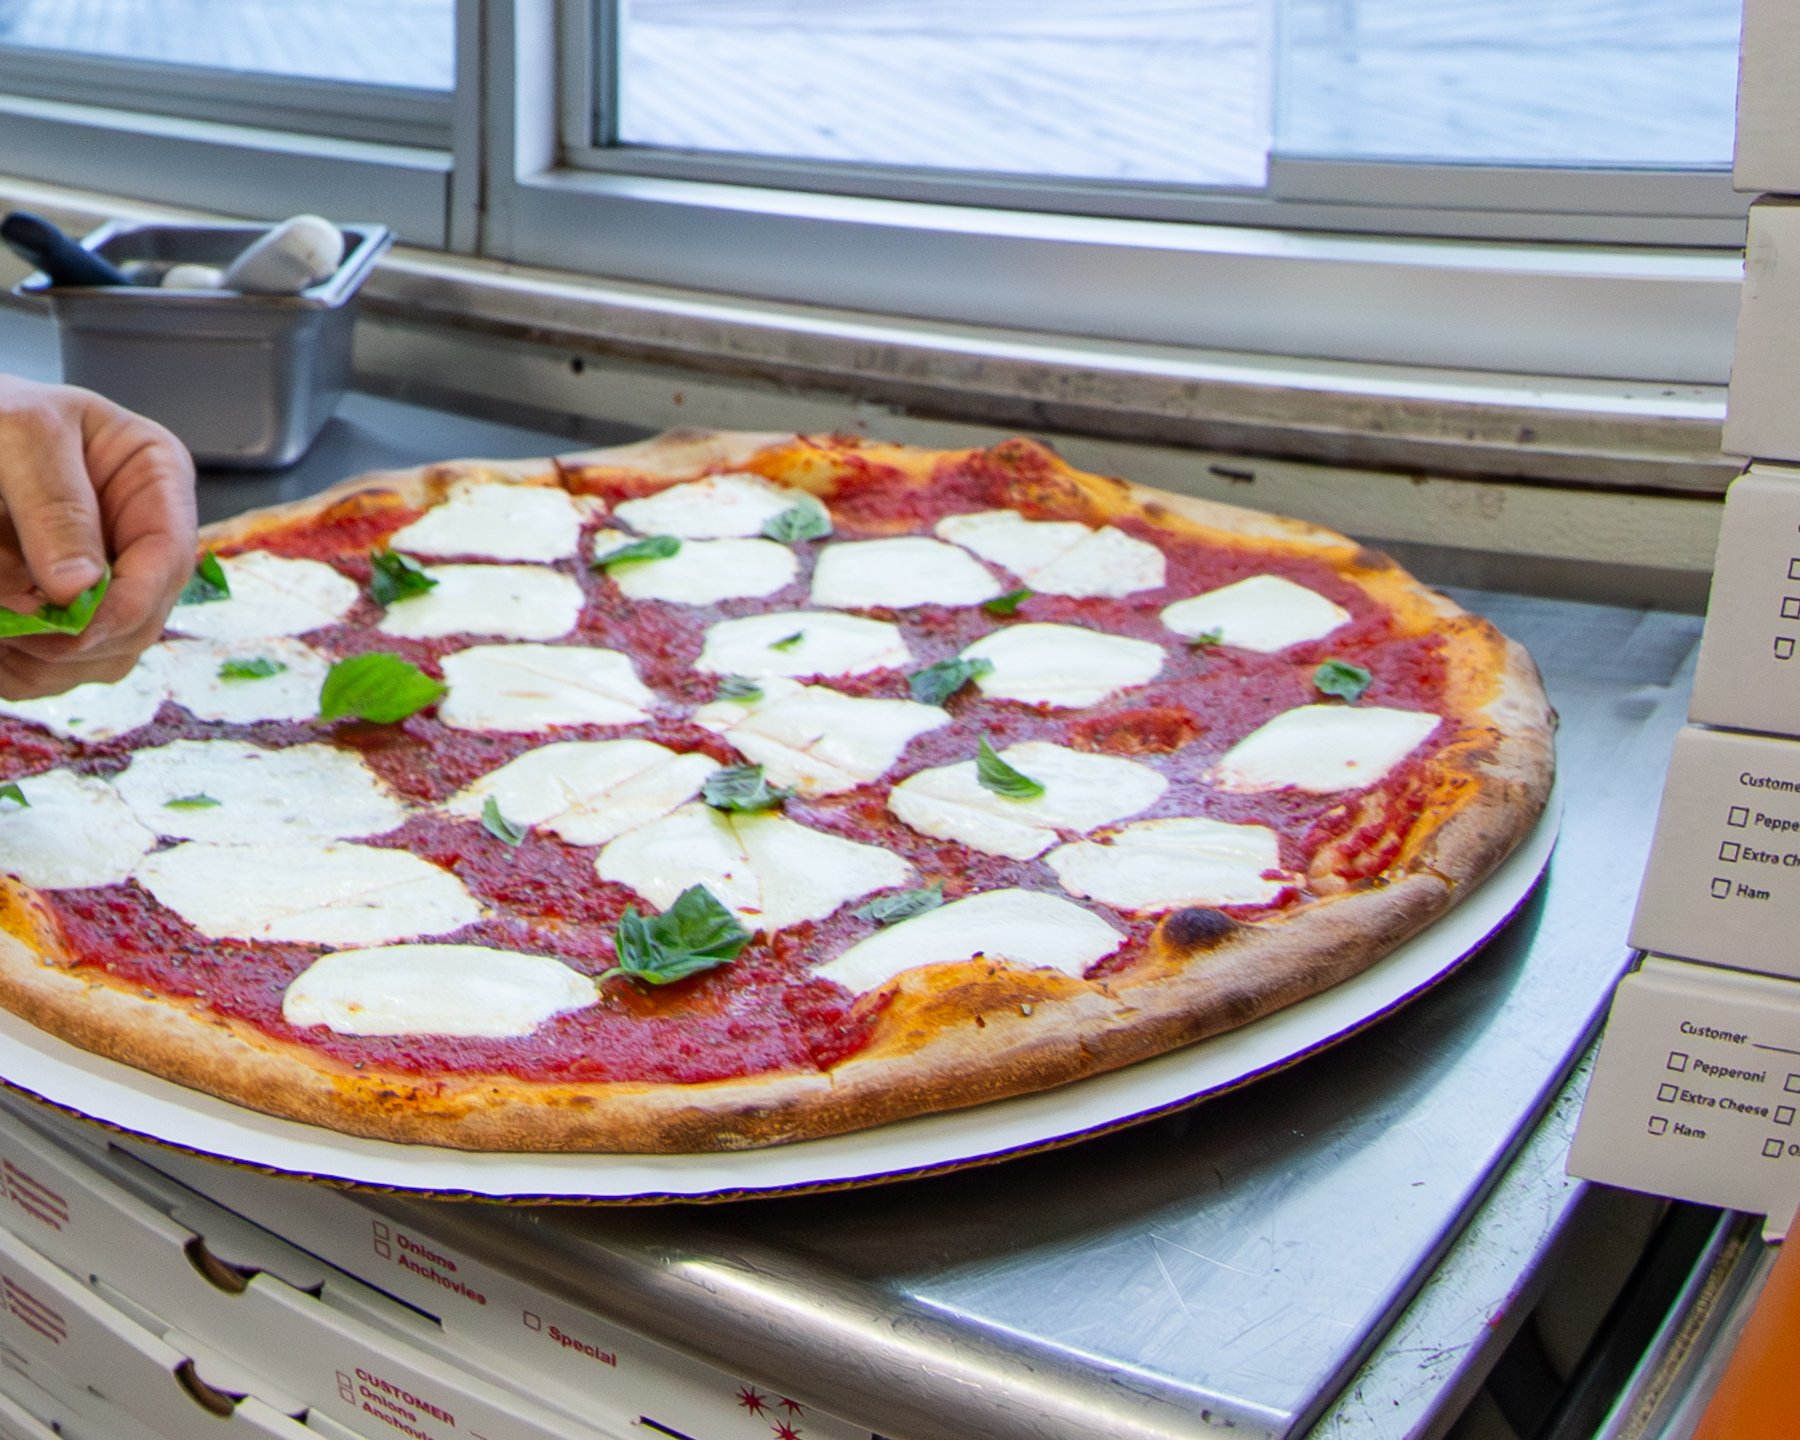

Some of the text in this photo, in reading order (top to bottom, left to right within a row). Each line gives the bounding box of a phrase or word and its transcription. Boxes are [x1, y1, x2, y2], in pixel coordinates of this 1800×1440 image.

[1742, 846, 1779, 865] Extra
[1736, 882, 1771, 901] Ham
[1680, 1020, 1749, 1044] Customer
[1692, 1058, 1767, 1083] Pepperoni
[1680, 1089, 1769, 1119] Extra Cheese
[1672, 1121, 1707, 1140] Ham
[395, 1232, 458, 1274] Onions
[397, 1253, 488, 1306] Anchovies
[547, 1324, 618, 1368] Special
[354, 1367, 456, 1428] CUSTOMER
[358, 1384, 418, 1424] Onions
